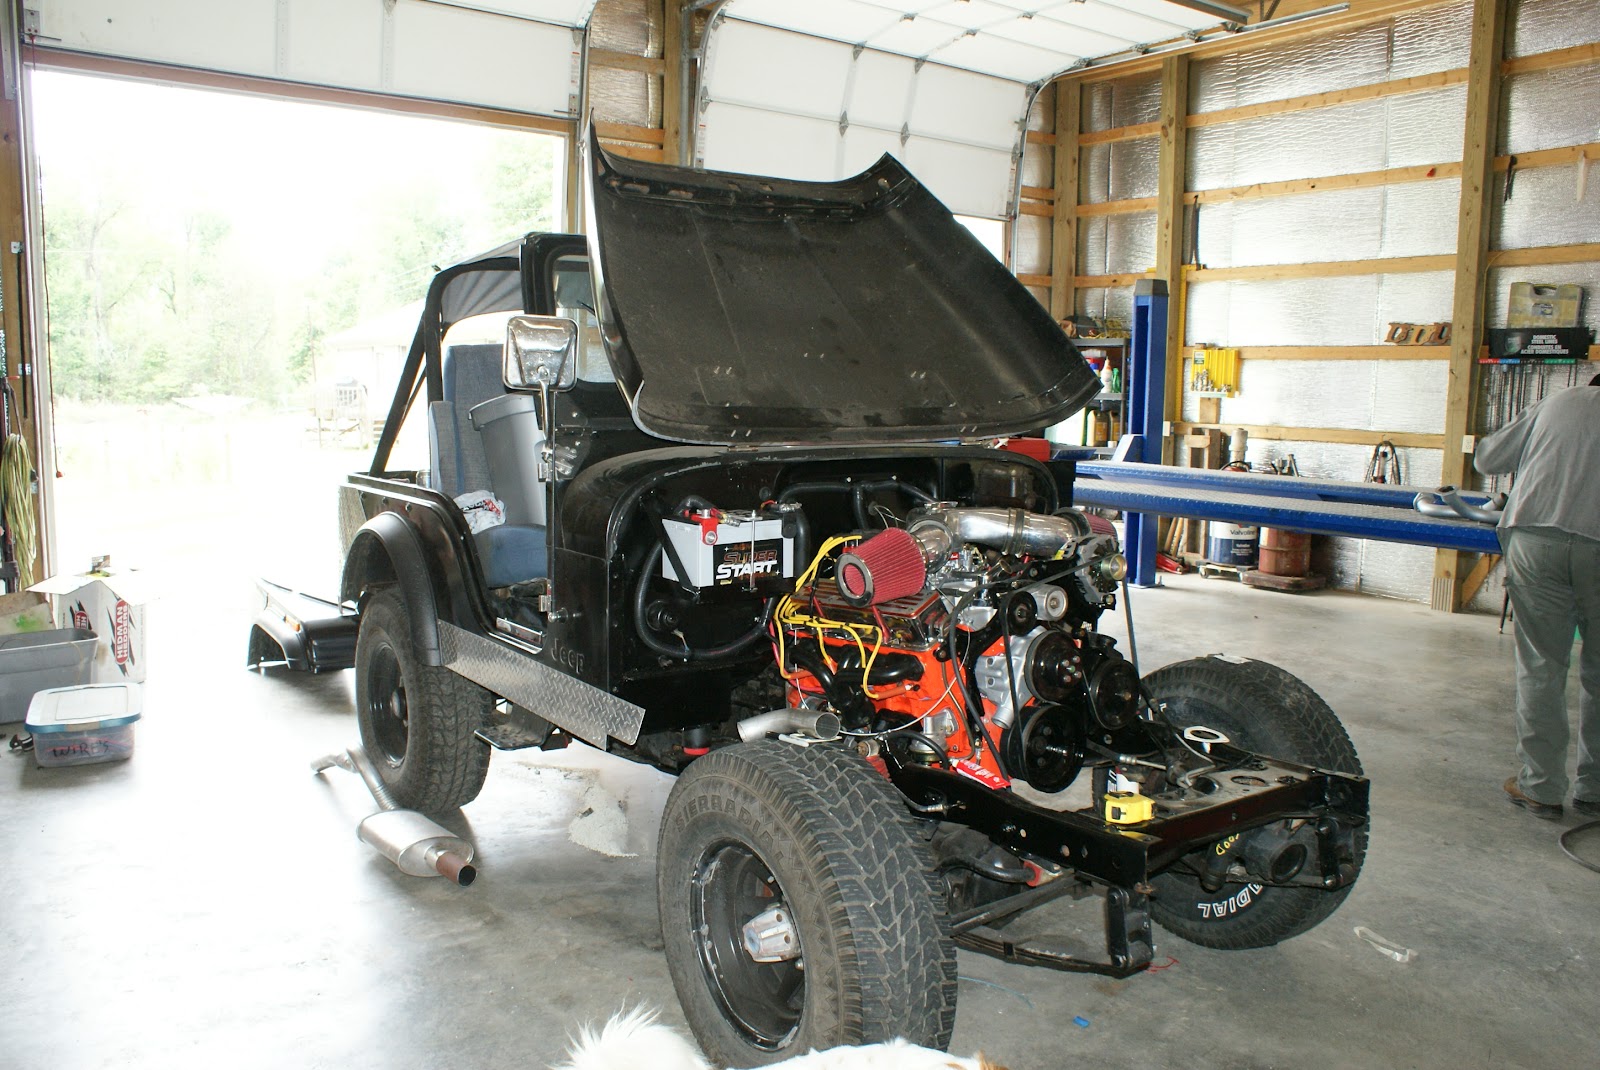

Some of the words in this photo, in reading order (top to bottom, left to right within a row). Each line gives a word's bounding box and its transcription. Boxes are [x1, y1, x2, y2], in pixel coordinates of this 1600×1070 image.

[724, 549, 778, 566] SUPER
[716, 560, 778, 580] START
[551, 637, 585, 675] Jeep
